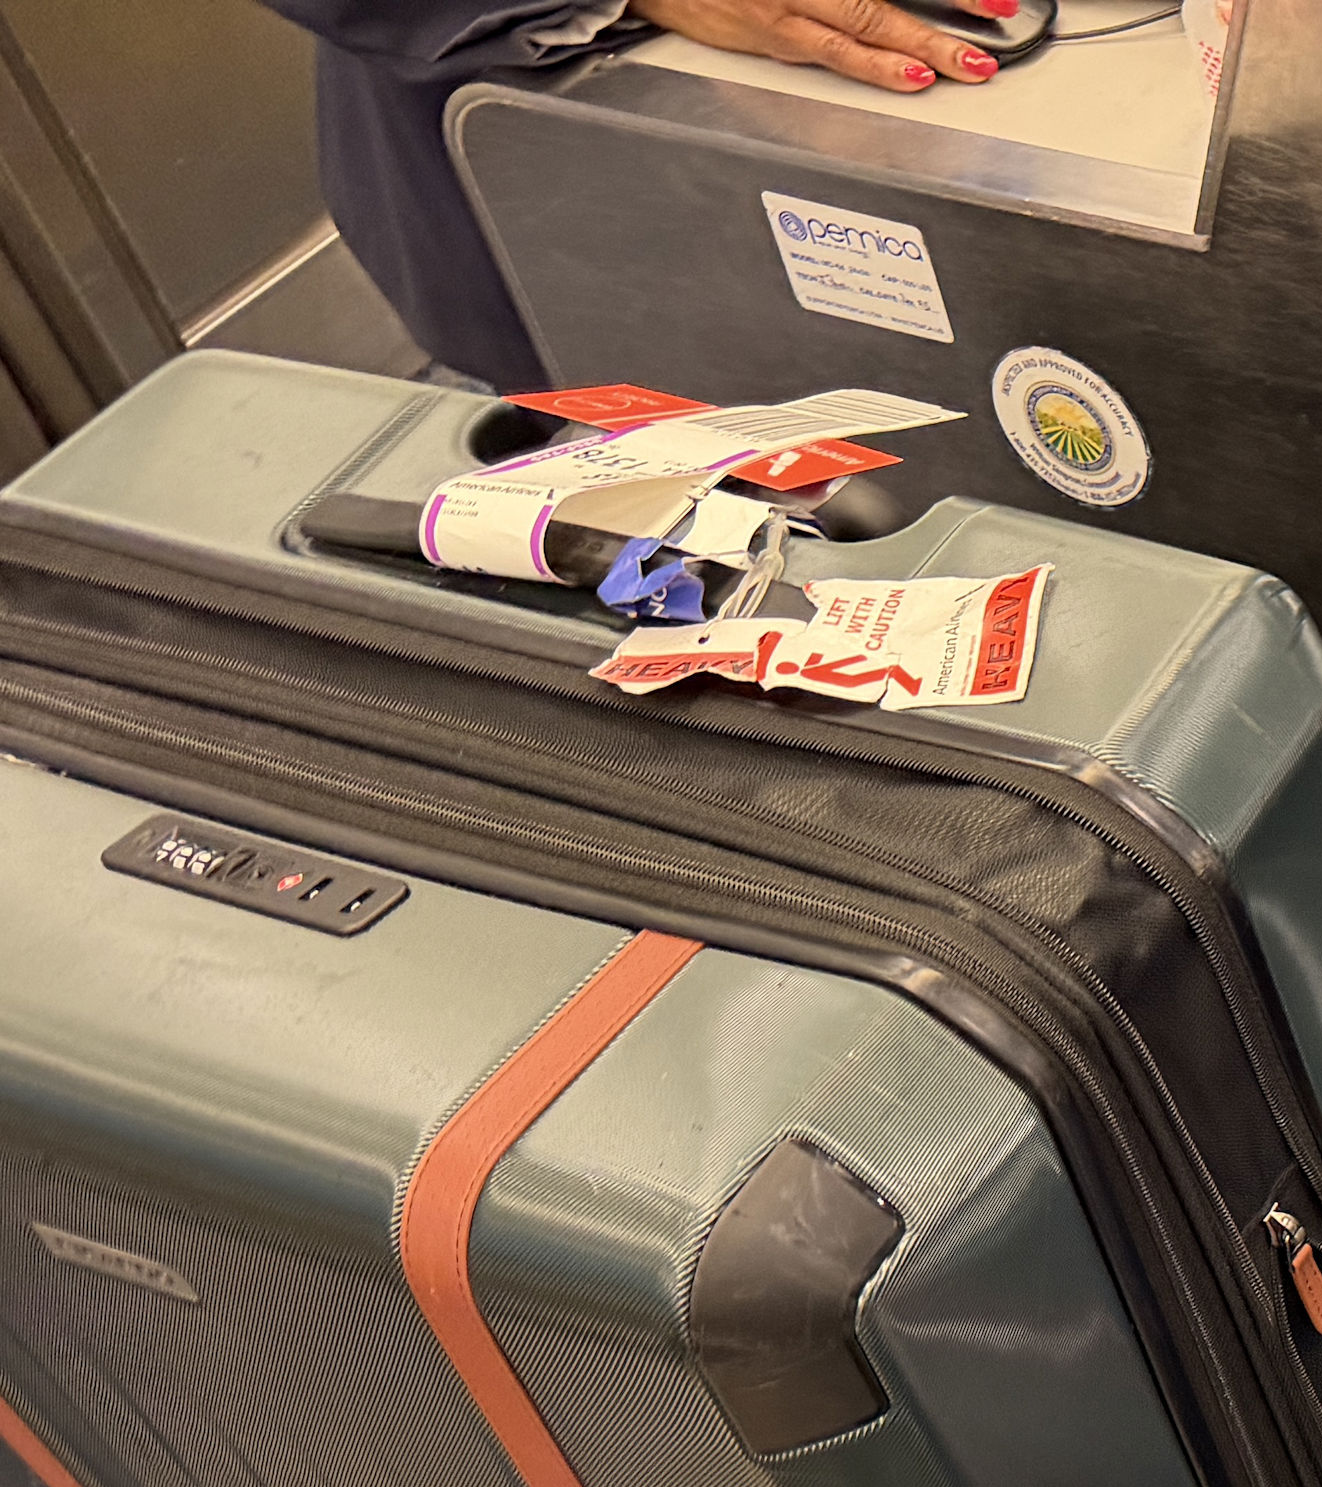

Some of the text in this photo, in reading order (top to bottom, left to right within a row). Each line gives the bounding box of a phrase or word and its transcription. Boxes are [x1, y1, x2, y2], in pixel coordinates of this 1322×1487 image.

[1084, 376, 1103, 395] FOR
[1100, 393, 1134, 438] ACCURACY
[822, 596, 851, 627] LIFT
[844, 597, 878, 635] WITH
[864, 588, 907, 652] CAUTION
[981, 574, 1033, 691] HEAVY
[932, 635, 959, 697] American
